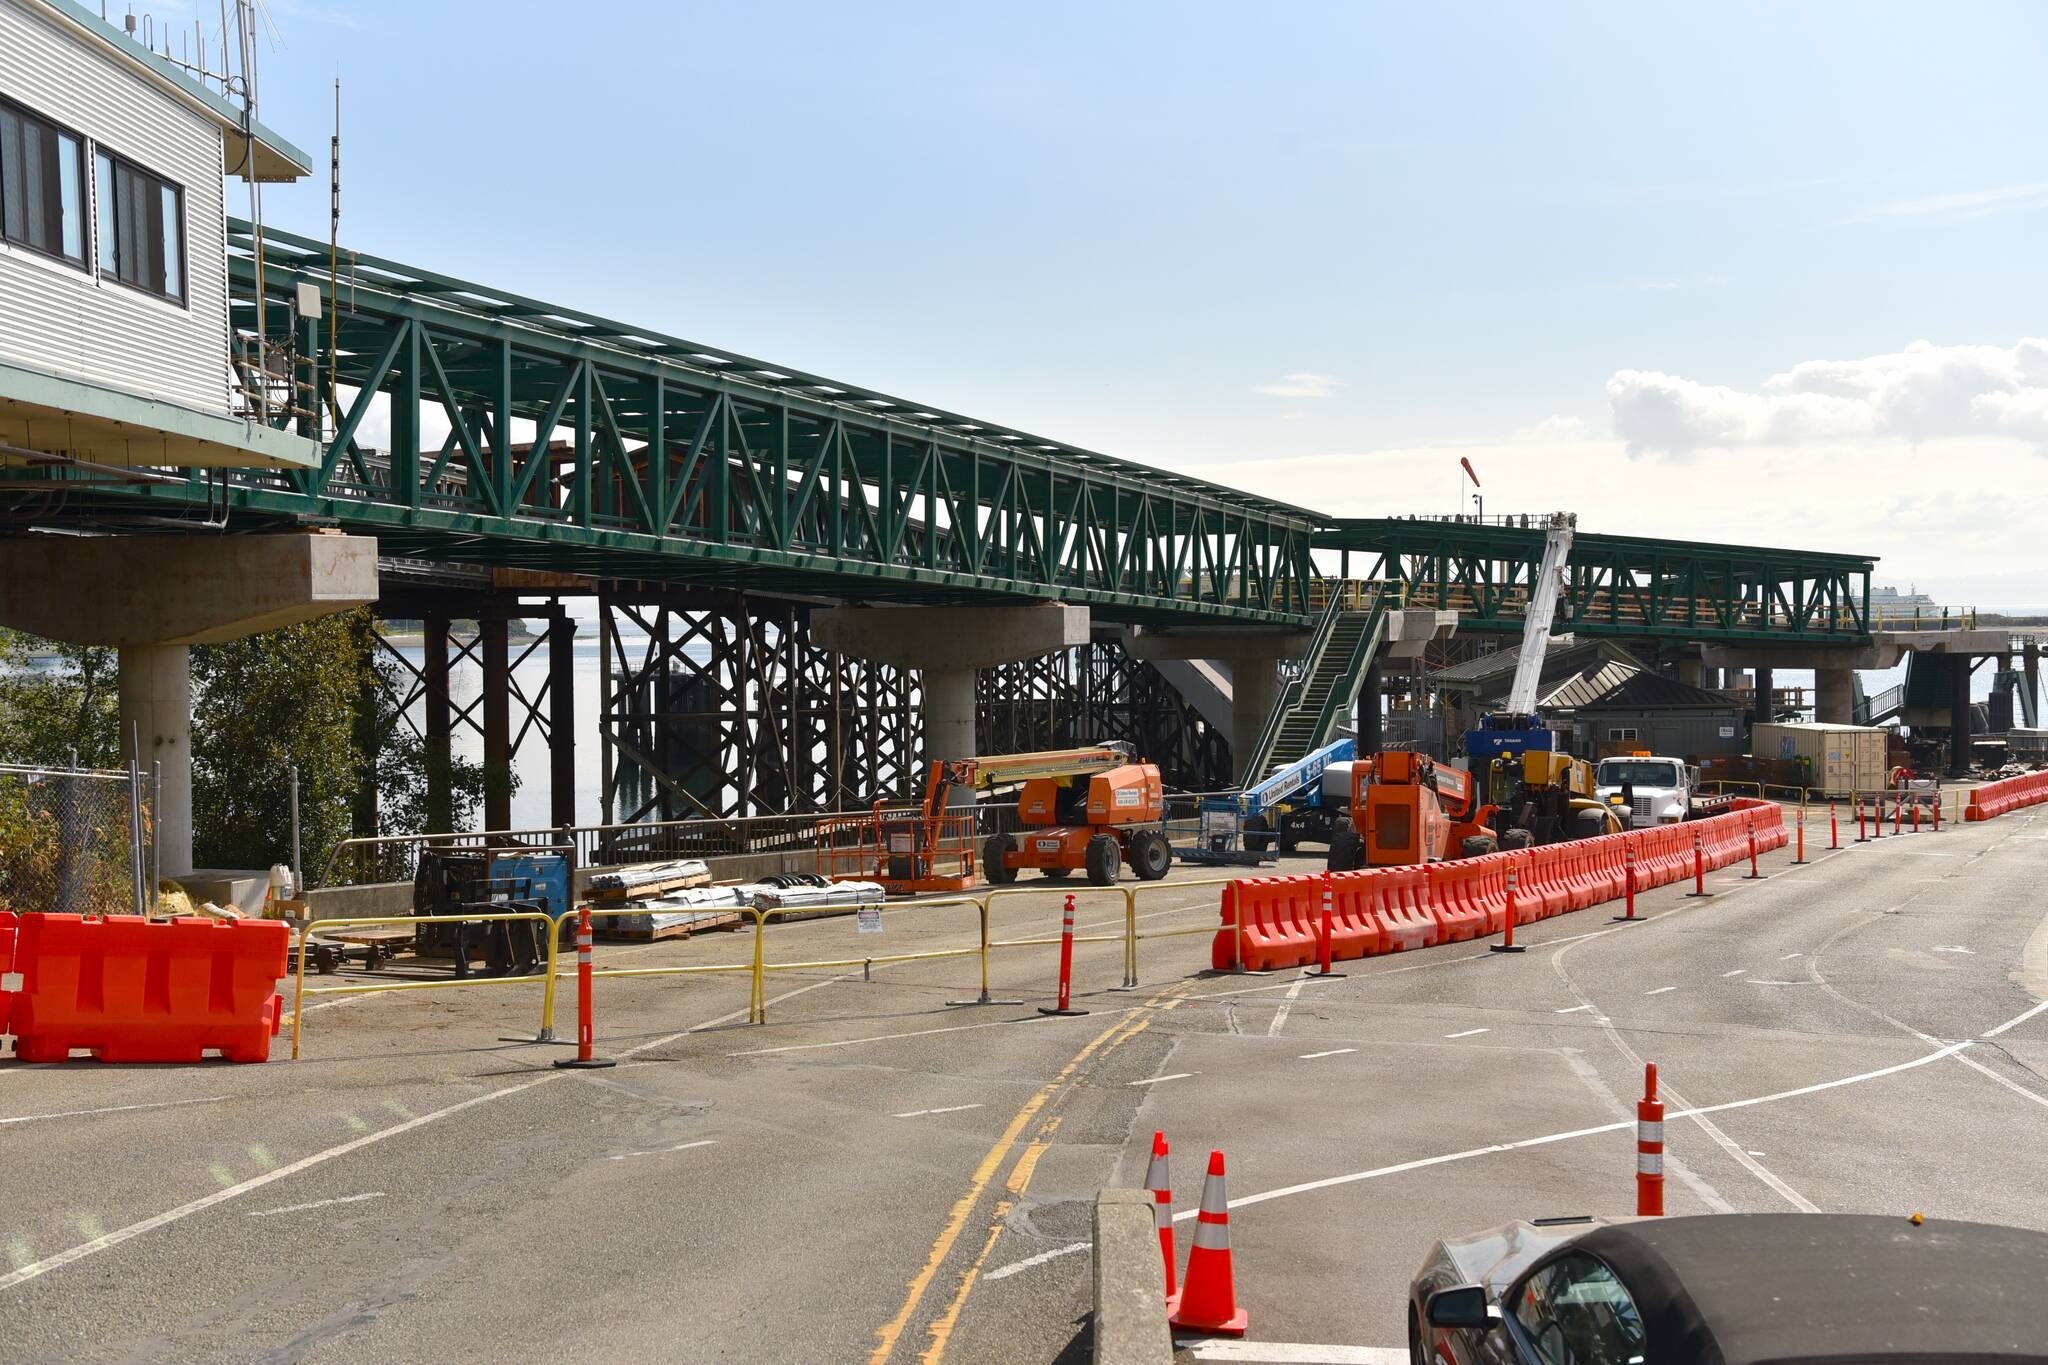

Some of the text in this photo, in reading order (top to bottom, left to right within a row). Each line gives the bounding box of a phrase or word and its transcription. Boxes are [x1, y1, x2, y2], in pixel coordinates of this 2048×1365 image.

[1268, 775, 1300, 800] United Rentals
[1290, 821, 1305, 829] 4x4
